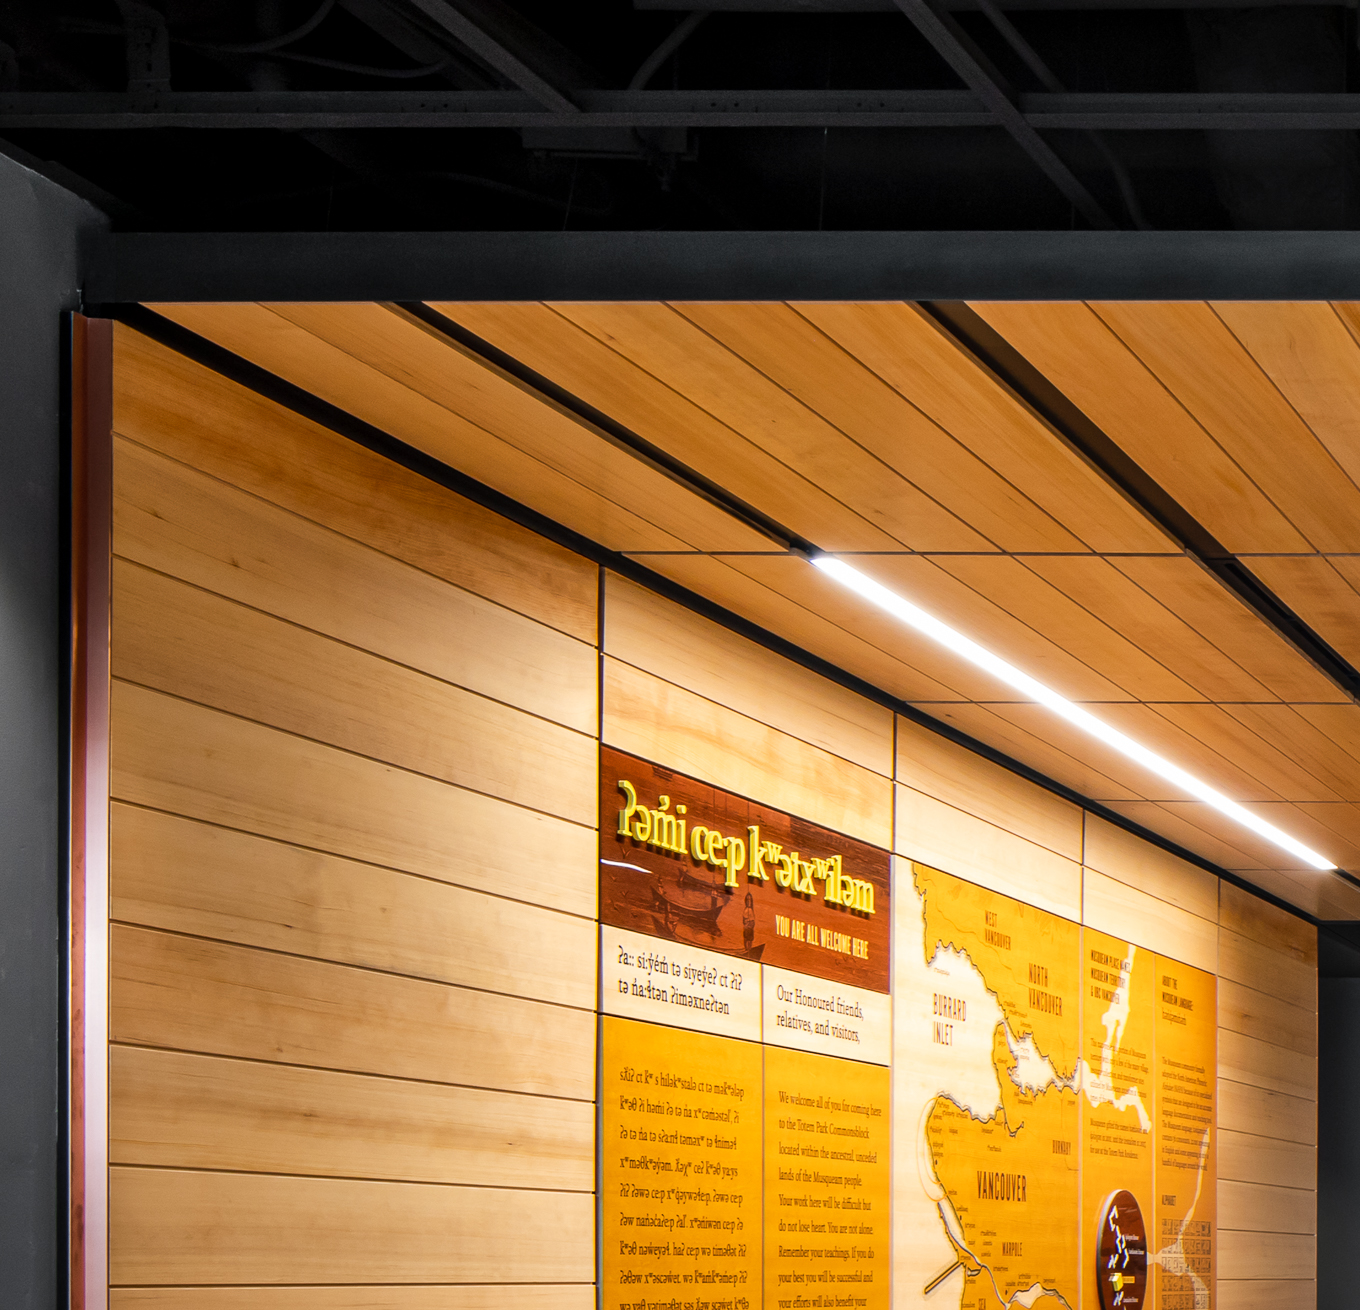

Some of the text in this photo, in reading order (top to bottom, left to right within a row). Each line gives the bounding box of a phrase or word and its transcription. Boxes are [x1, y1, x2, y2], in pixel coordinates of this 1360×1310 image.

[985, 910, 997, 928] WEST
[775, 914, 869, 960] YOU ARE ALL WELCOME HERE
[985, 928, 1011, 951] VANCOUVER
[720, 975, 728, 988] ct
[1029, 963, 1048, 988] NORTH
[777, 985, 864, 1020] Our Honoured friends,
[933, 993, 966, 1022] BURRARD
[1029, 988, 1062, 1017] VANCOUVER
[776, 1014, 860, 1043] relatives, and visitors,
[933, 1021, 953, 1046] INLET
[779, 1091, 789, 1104] We
[790, 1093, 815, 1108] welcome
[825, 1097, 830, 1110] of
[830, 1101, 841, 1113] you
[842, 1099, 850, 1112] for
[850, 1104, 869, 1118] coming
[871, 1104, 882, 1117] here
[779, 1119, 785, 1129] to
[786, 1118, 796, 1130] the
[797, 1119, 815, 1133] Totem
[816, 1121, 828, 1134] Park
[779, 1142, 800, 1156] located
[801, 1145, 819, 1158] within
[820, 1146, 829, 1159] the
[856, 1152, 877, 1164] unceded
[1053, 1140, 1071, 1155] BURNABY
[779, 1167, 794, 1181] lands
[796, 1169, 802, 1182] of
[803, 1170, 812, 1183] the
[813, 1172, 843, 1187] Musqueam
[977, 1171, 1027, 1202] VANCOUVER
[1002, 1242, 1022, 1256] MARPOLE
